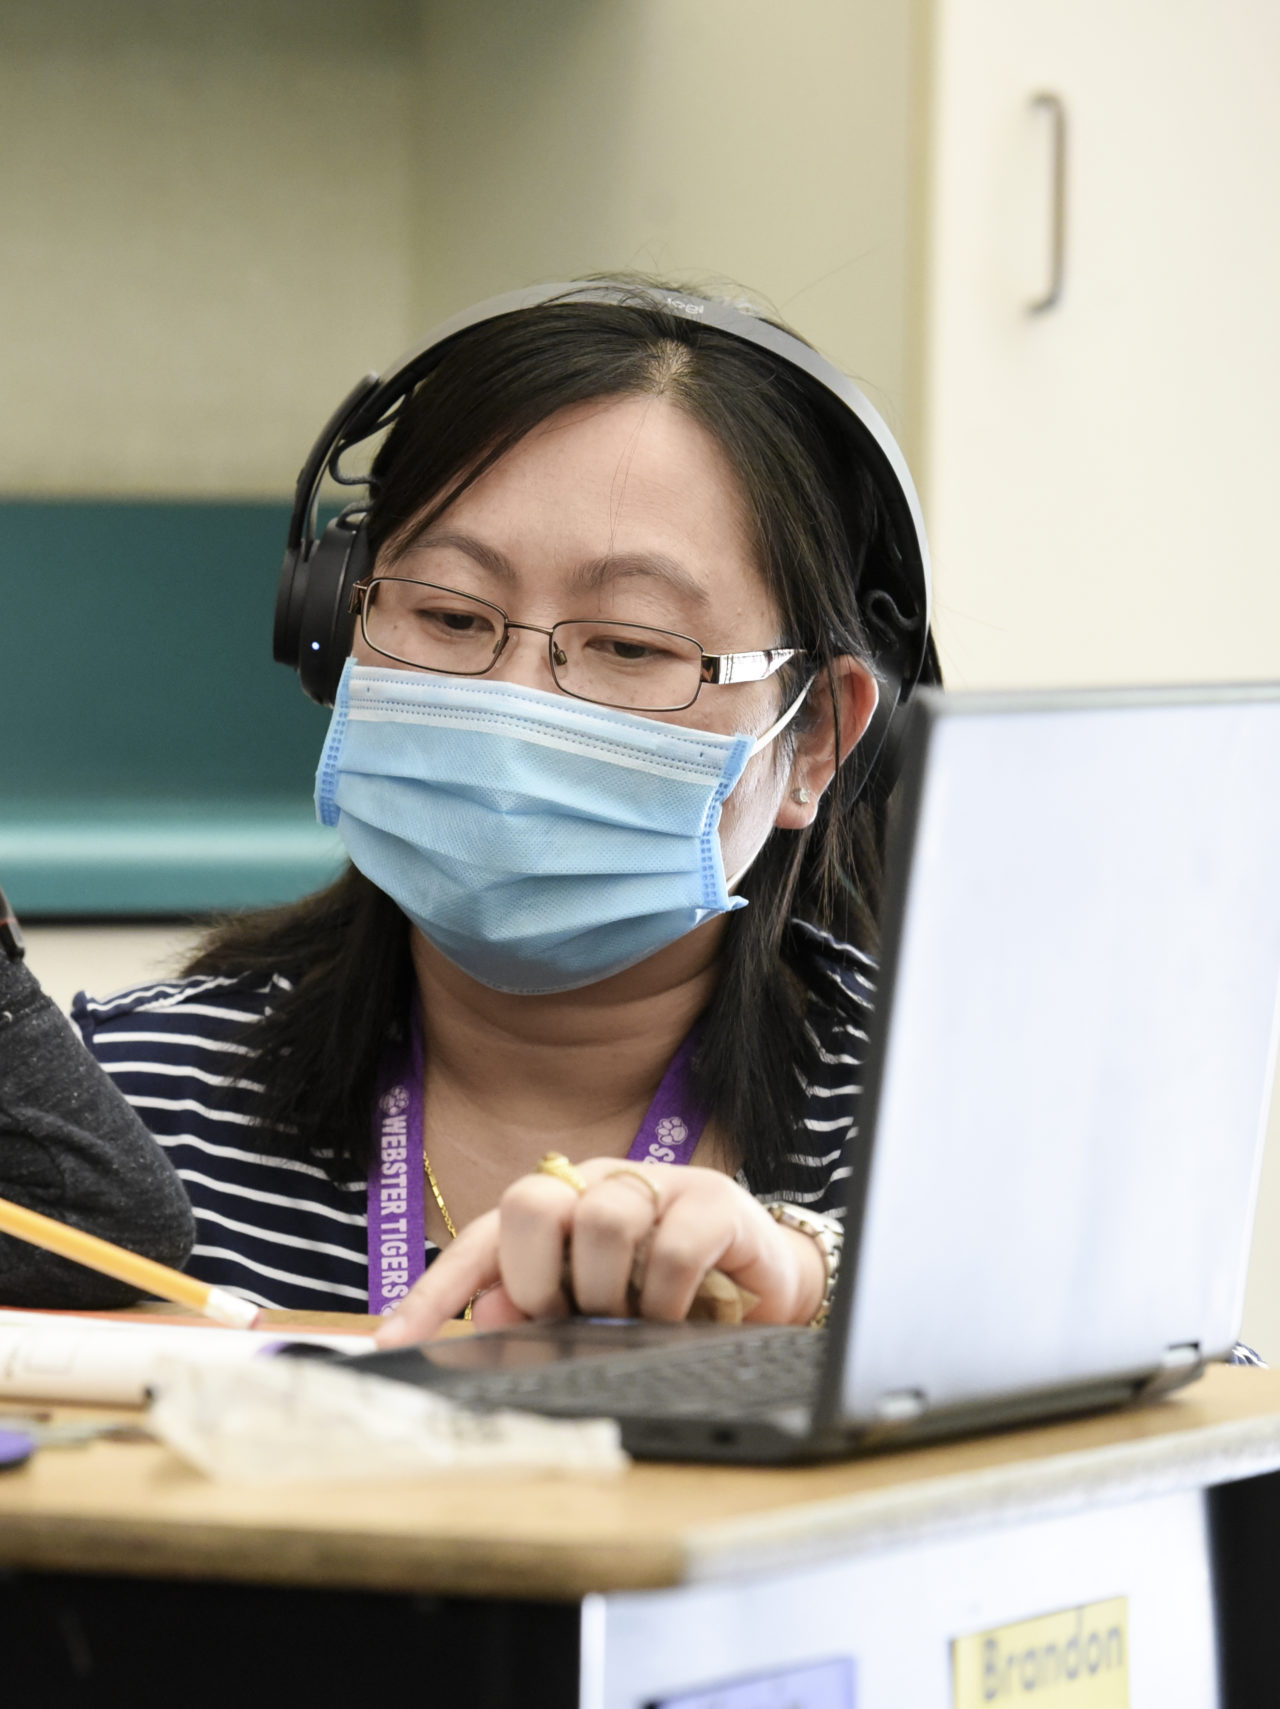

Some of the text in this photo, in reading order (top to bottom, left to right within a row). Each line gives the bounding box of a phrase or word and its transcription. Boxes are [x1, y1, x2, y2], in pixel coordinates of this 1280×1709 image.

[380, 1114, 408, 1300] WEBSTER TIGERS
[981, 1605, 1124, 1703] Brandon
